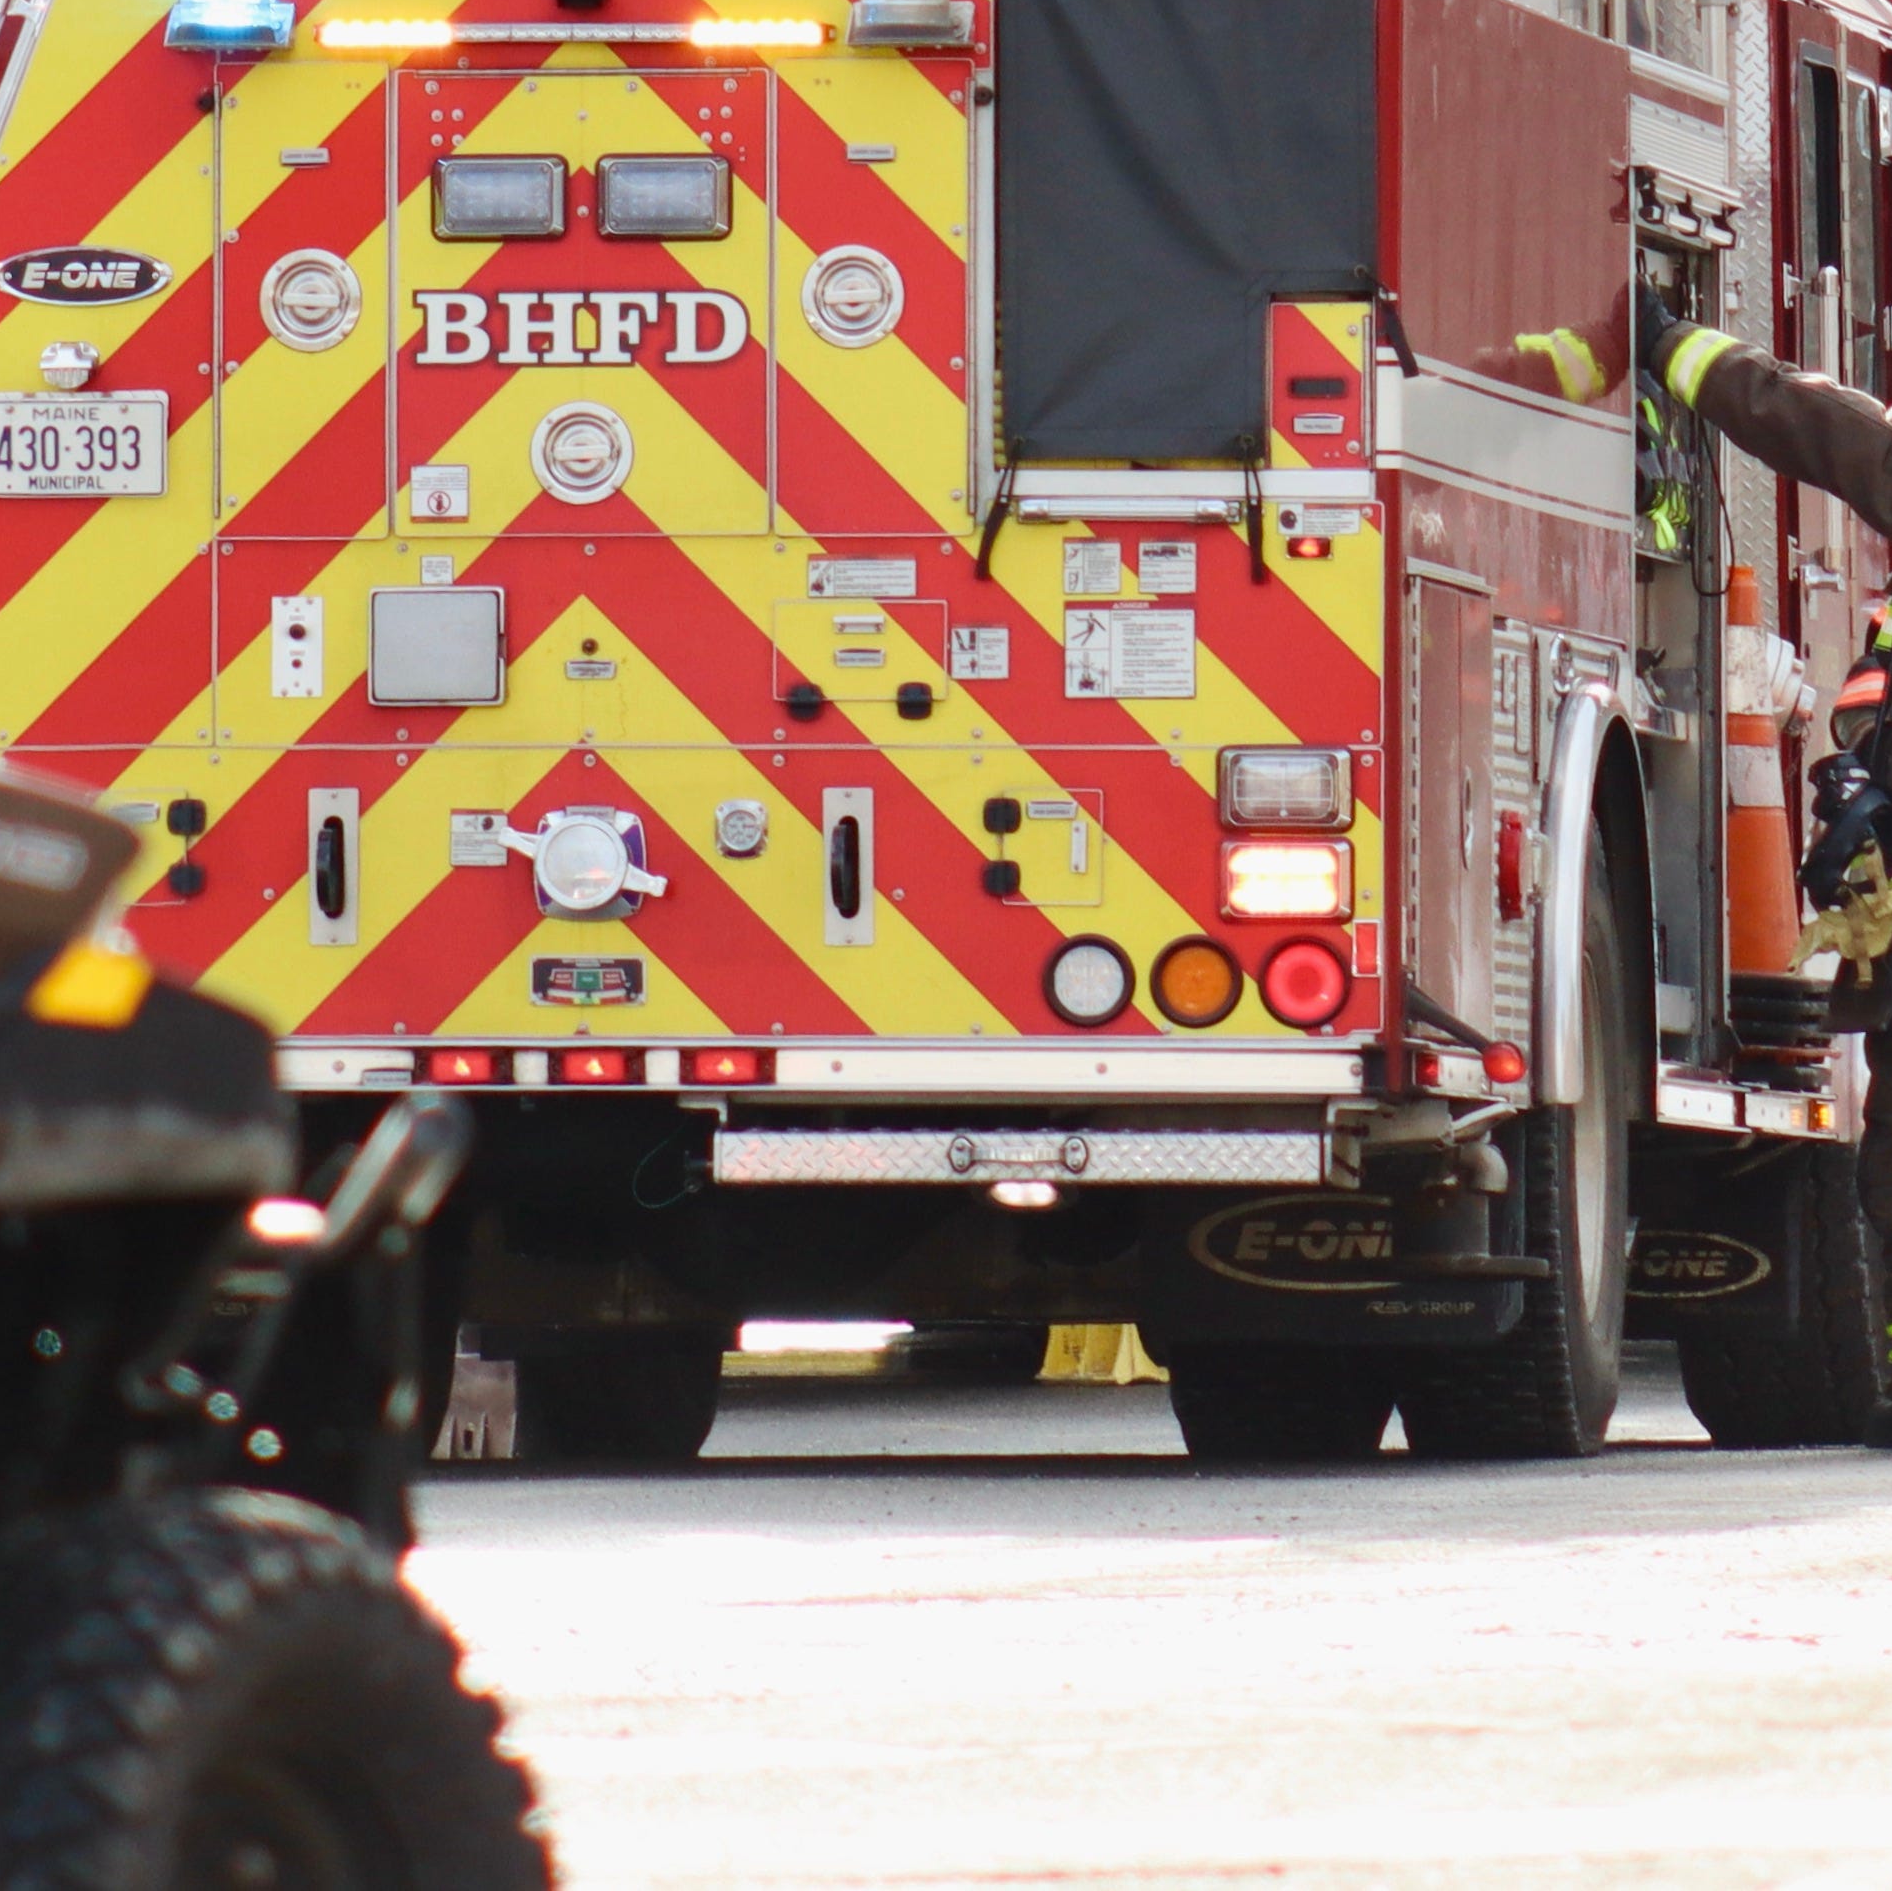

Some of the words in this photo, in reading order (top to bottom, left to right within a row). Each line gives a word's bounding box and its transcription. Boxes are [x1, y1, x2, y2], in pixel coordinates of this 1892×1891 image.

[21, 262, 141, 289] E-ONE
[416, 292, 748, 364] BHFD
[32, 407, 100, 422] MAINE
[28, 476, 106, 491] MUNICIPAL
[1234, 1220, 1394, 1260] E-ON
[1421, 1300, 1475, 1314] GROUP
